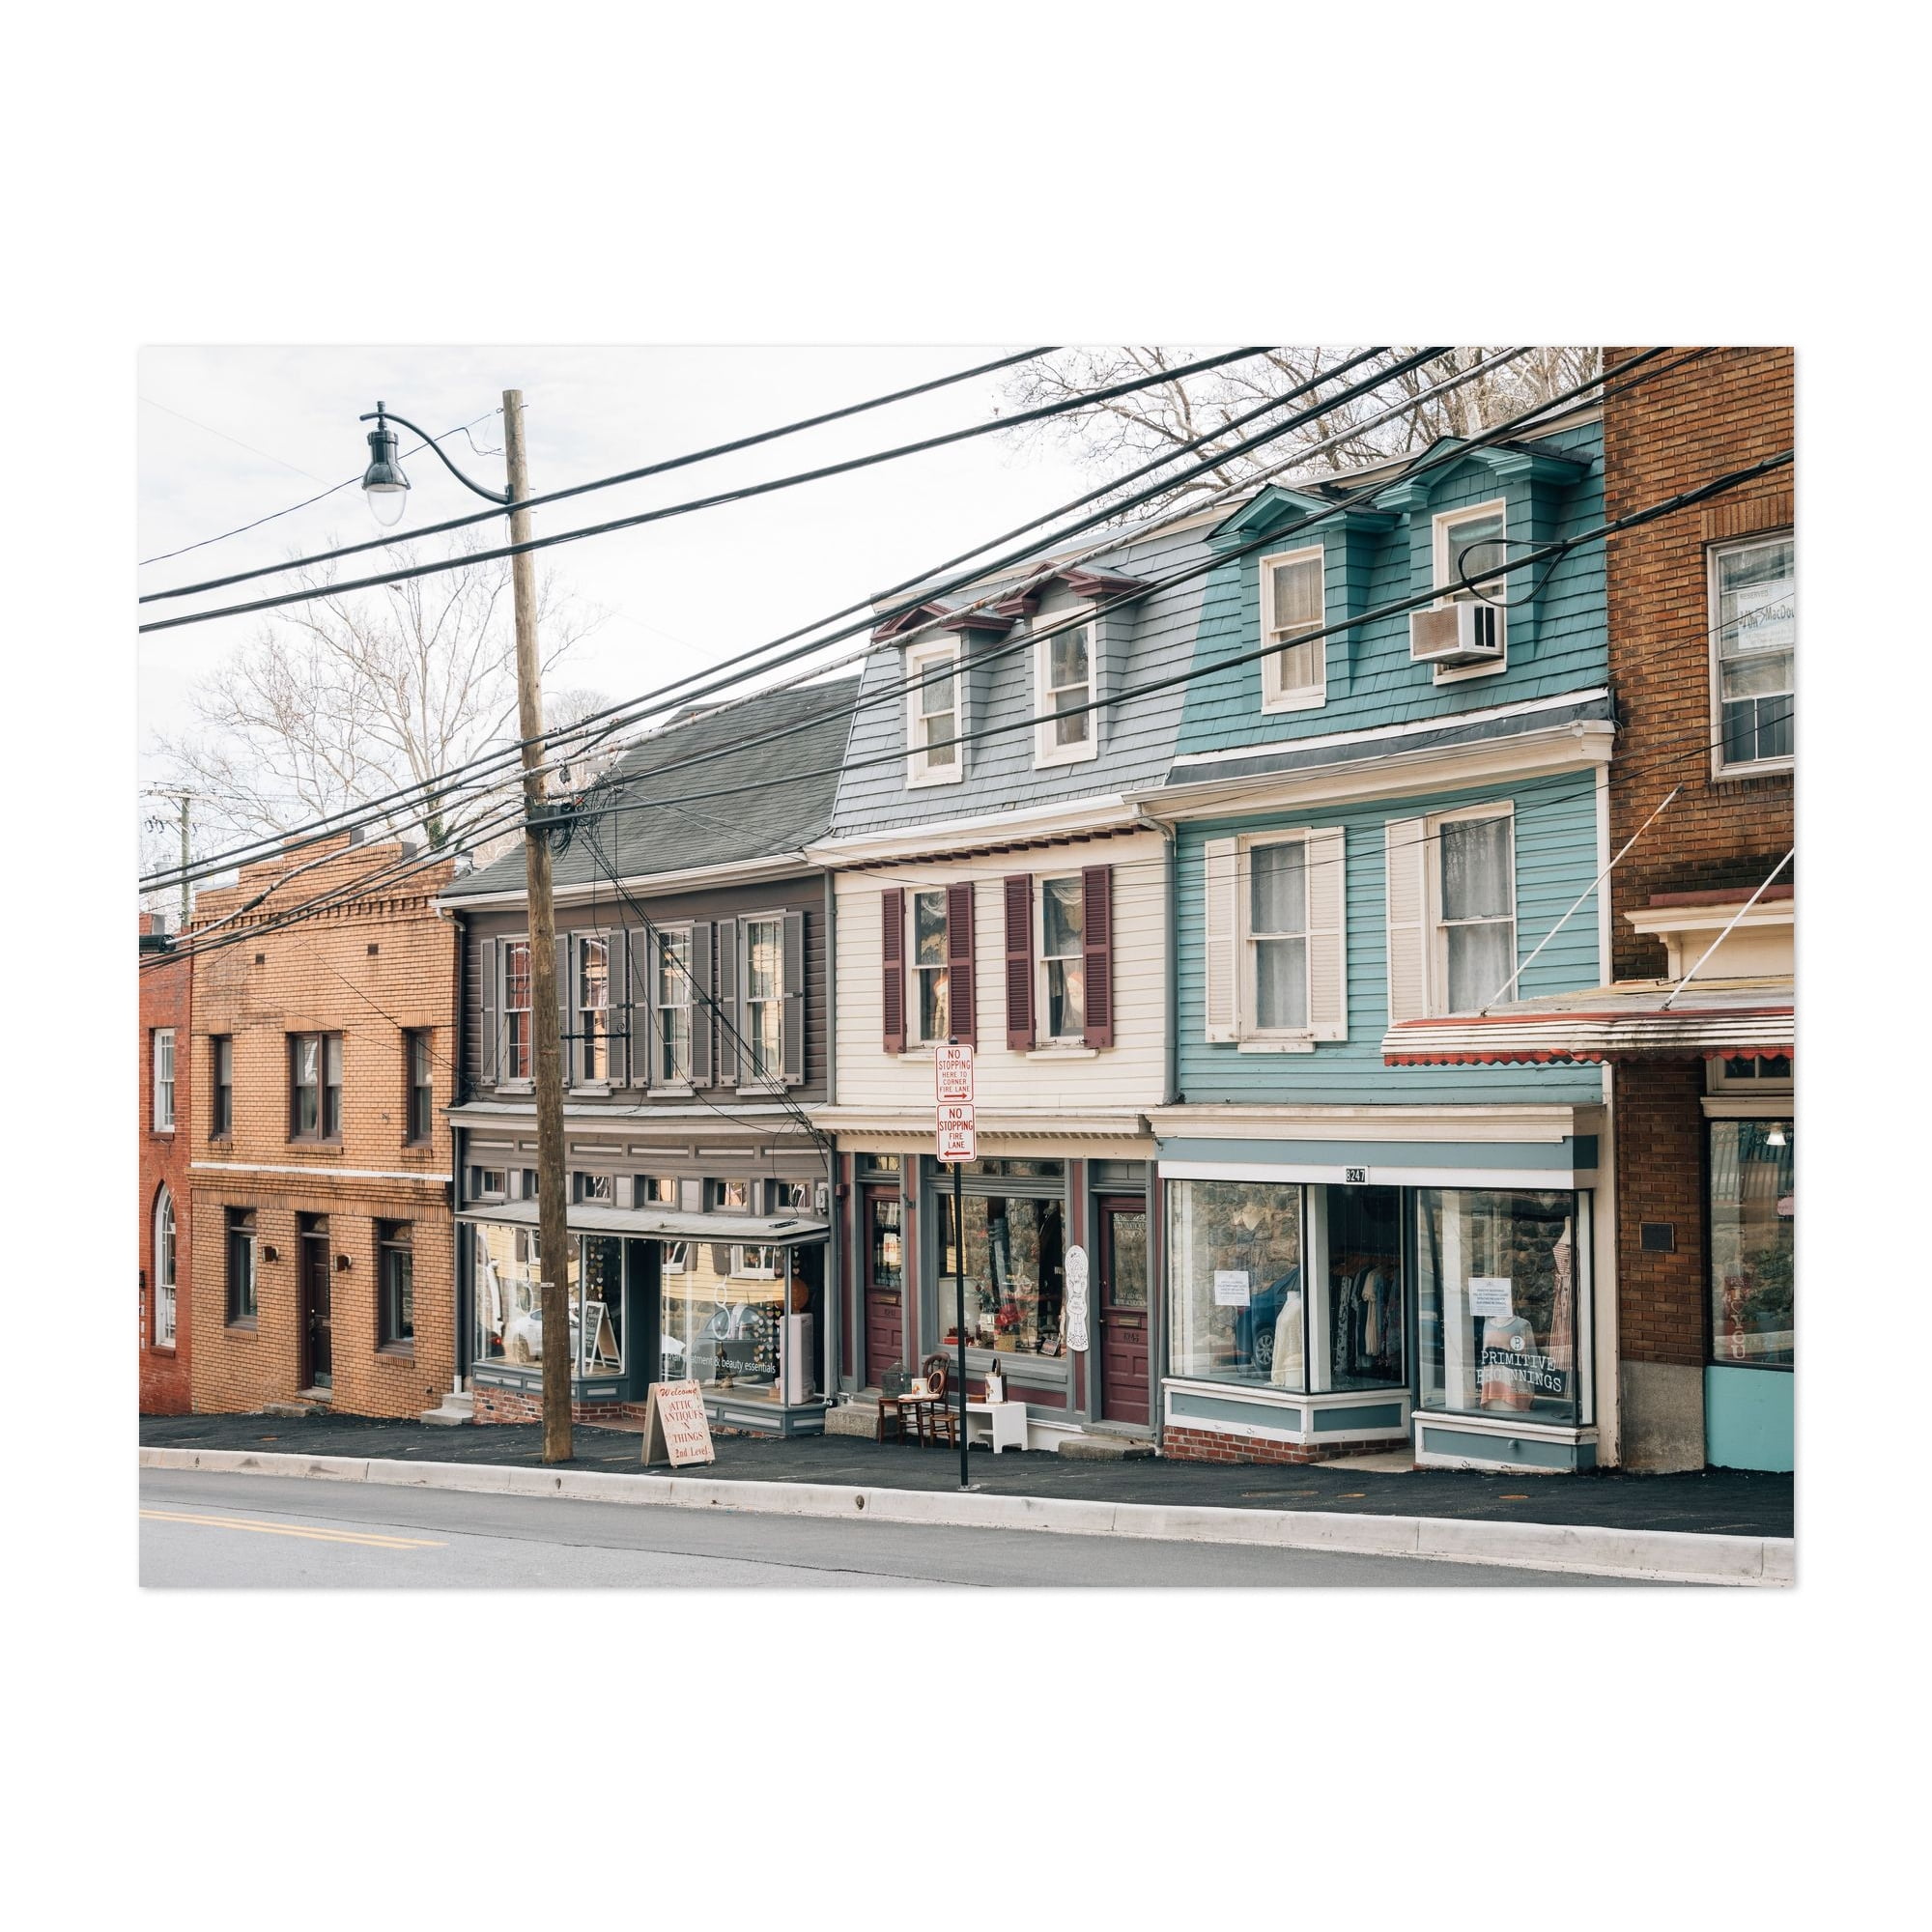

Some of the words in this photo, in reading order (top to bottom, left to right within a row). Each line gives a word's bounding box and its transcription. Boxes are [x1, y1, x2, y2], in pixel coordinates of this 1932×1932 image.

[948, 1049, 961, 1060] NO
[938, 1060, 971, 1070] STOPPING
[949, 1108, 962, 1119] NO
[939, 1121, 973, 1131] STOPPING
[948, 1141, 965, 1150] LANE
[1346, 1169, 1365, 1181] 8247
[714, 1356, 721, 1368] &
[722, 1358, 744, 1373] beauty
[745, 1361, 776, 1374] essentials
[1481, 1350, 1556, 1372] PRIMITIVE
[1476, 1369, 1562, 1393] BEGNNINGS
[659, 1387, 697, 1397] Welcome
[669, 1400, 693, 1411] ATTIC
[665, 1410, 704, 1423] ANTIQUES
[673, 1431, 704, 1444] THINGS
[675, 1448, 687, 1459] 2nd
[691, 1445, 708, 1457] Level
